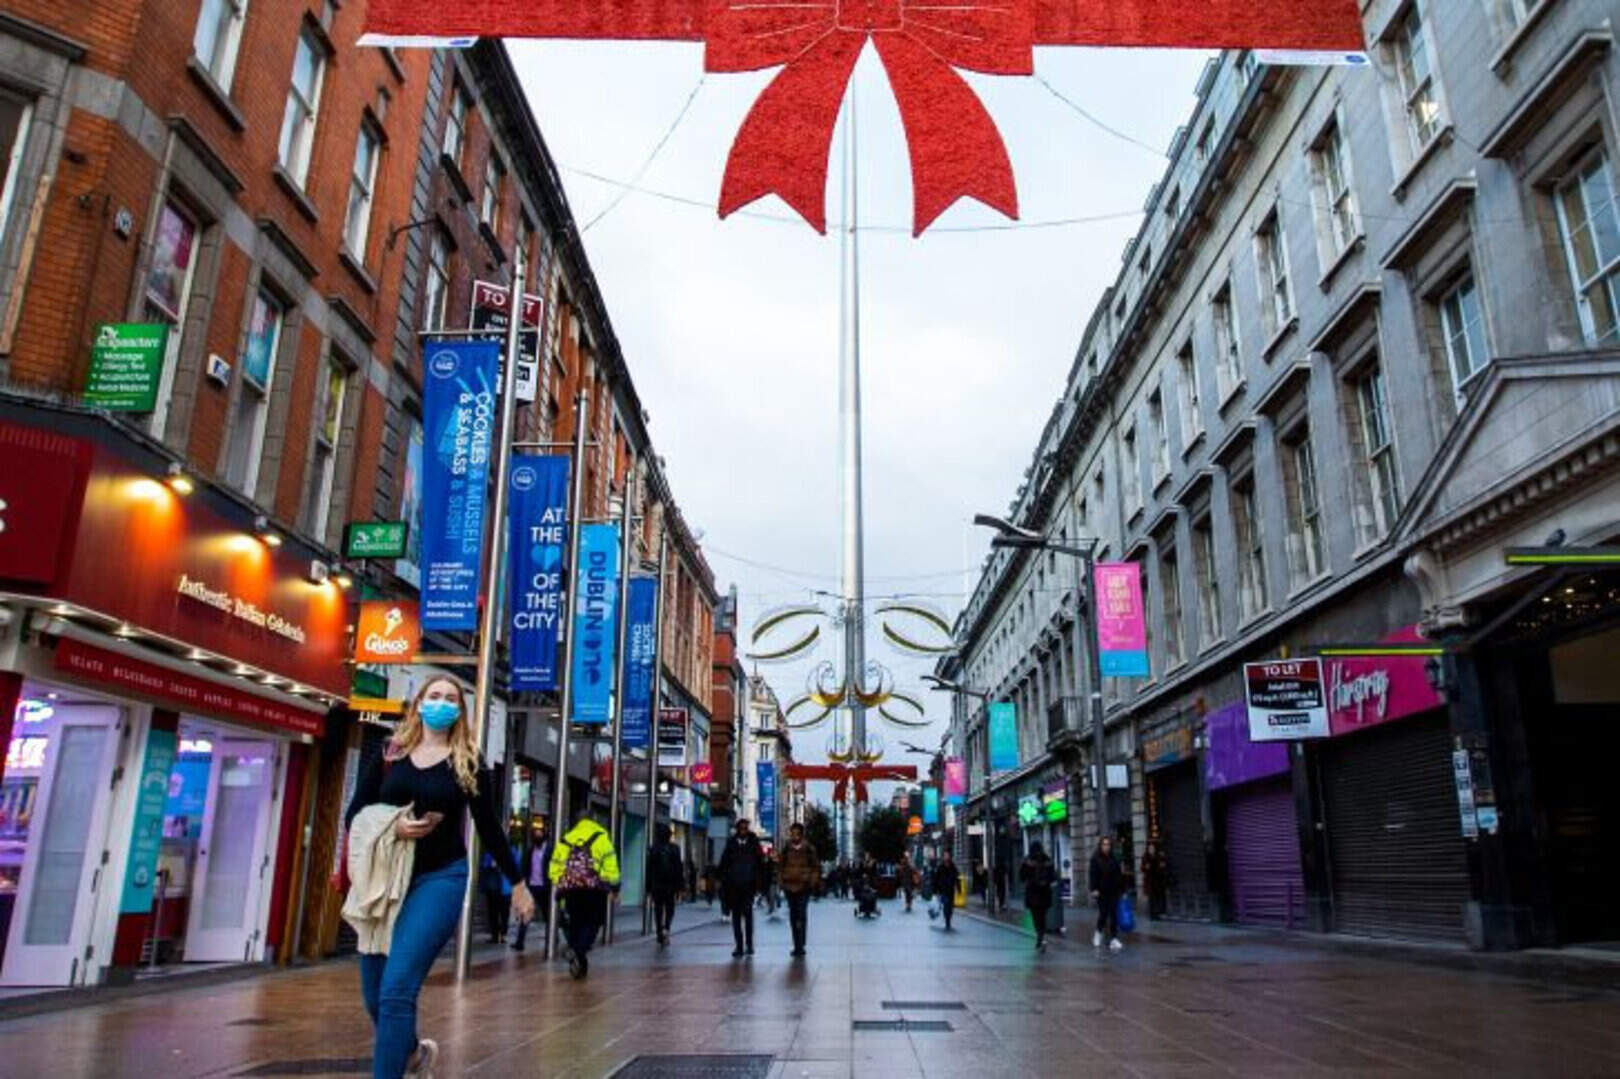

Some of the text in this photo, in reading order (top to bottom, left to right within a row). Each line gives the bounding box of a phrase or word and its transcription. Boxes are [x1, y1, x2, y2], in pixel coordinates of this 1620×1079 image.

[482, 288, 506, 306] TO
[469, 391, 491, 465] COCKLES
[451, 407, 473, 475] SEABASS
[445, 494, 465, 539] SUSHI
[462, 485, 484, 554] MUSSELS
[541, 506, 564, 524] AT
[529, 526, 564, 543] THE
[533, 573, 560, 590] OF
[584, 550, 607, 632] DUBLIN
[525, 593, 558, 609] THE
[513, 612, 556, 630] CITY
[1263, 664, 1302, 677] TO LET
